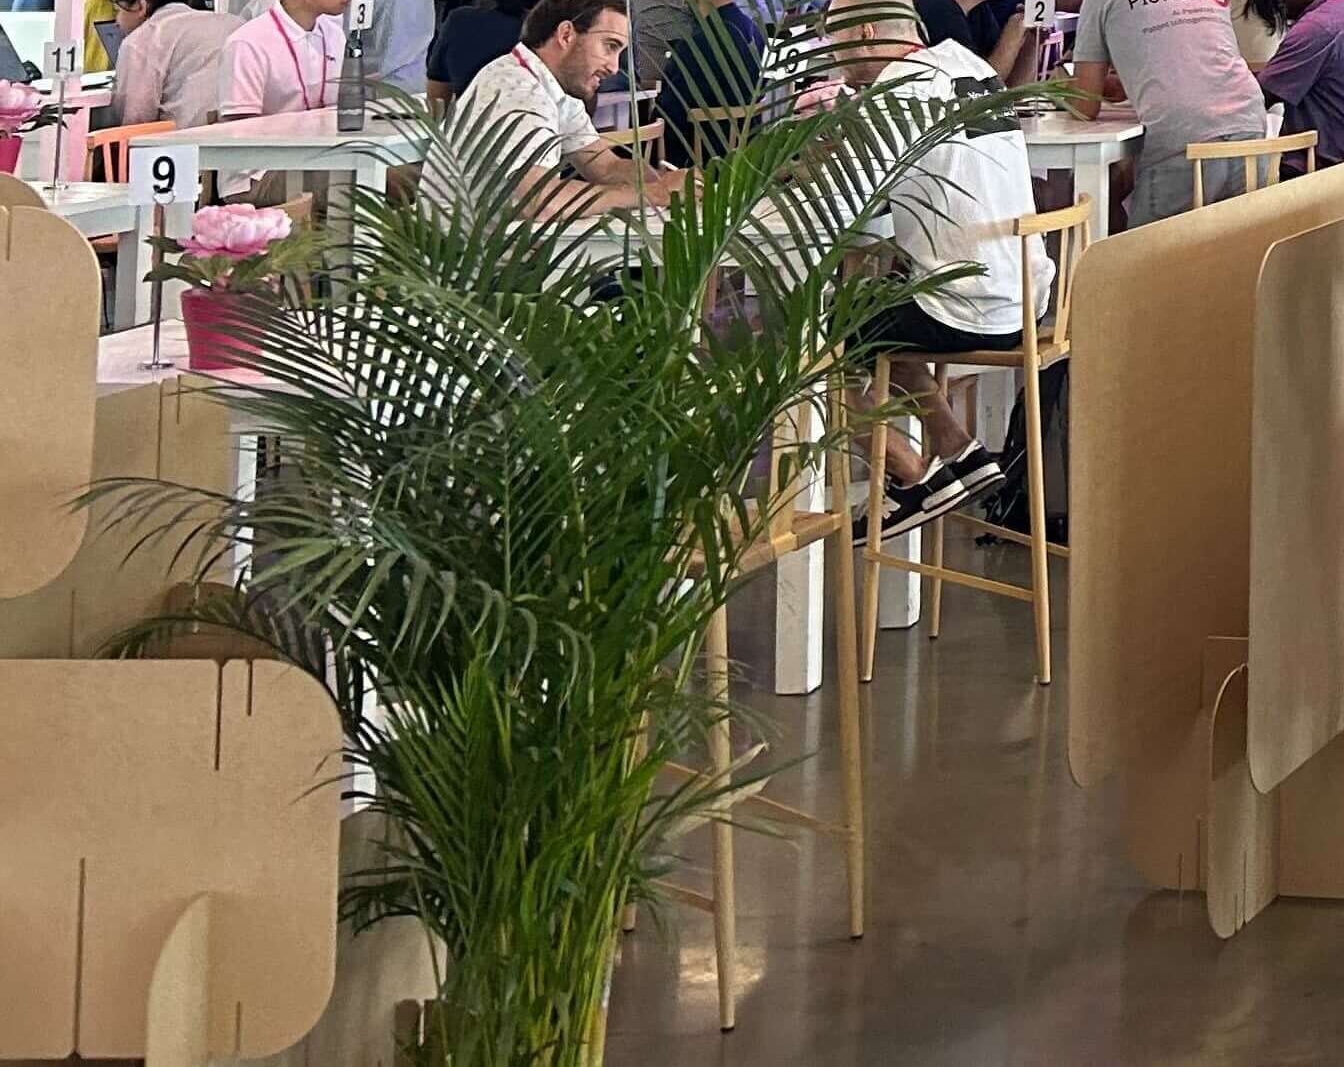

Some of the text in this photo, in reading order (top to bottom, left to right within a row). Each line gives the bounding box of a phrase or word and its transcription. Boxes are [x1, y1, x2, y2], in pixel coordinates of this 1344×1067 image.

[357, 3, 366, 24] 3
[1034, 0, 1045, 22] 2
[52, 46, 76, 72] 11
[152, 155, 176, 194] 9
